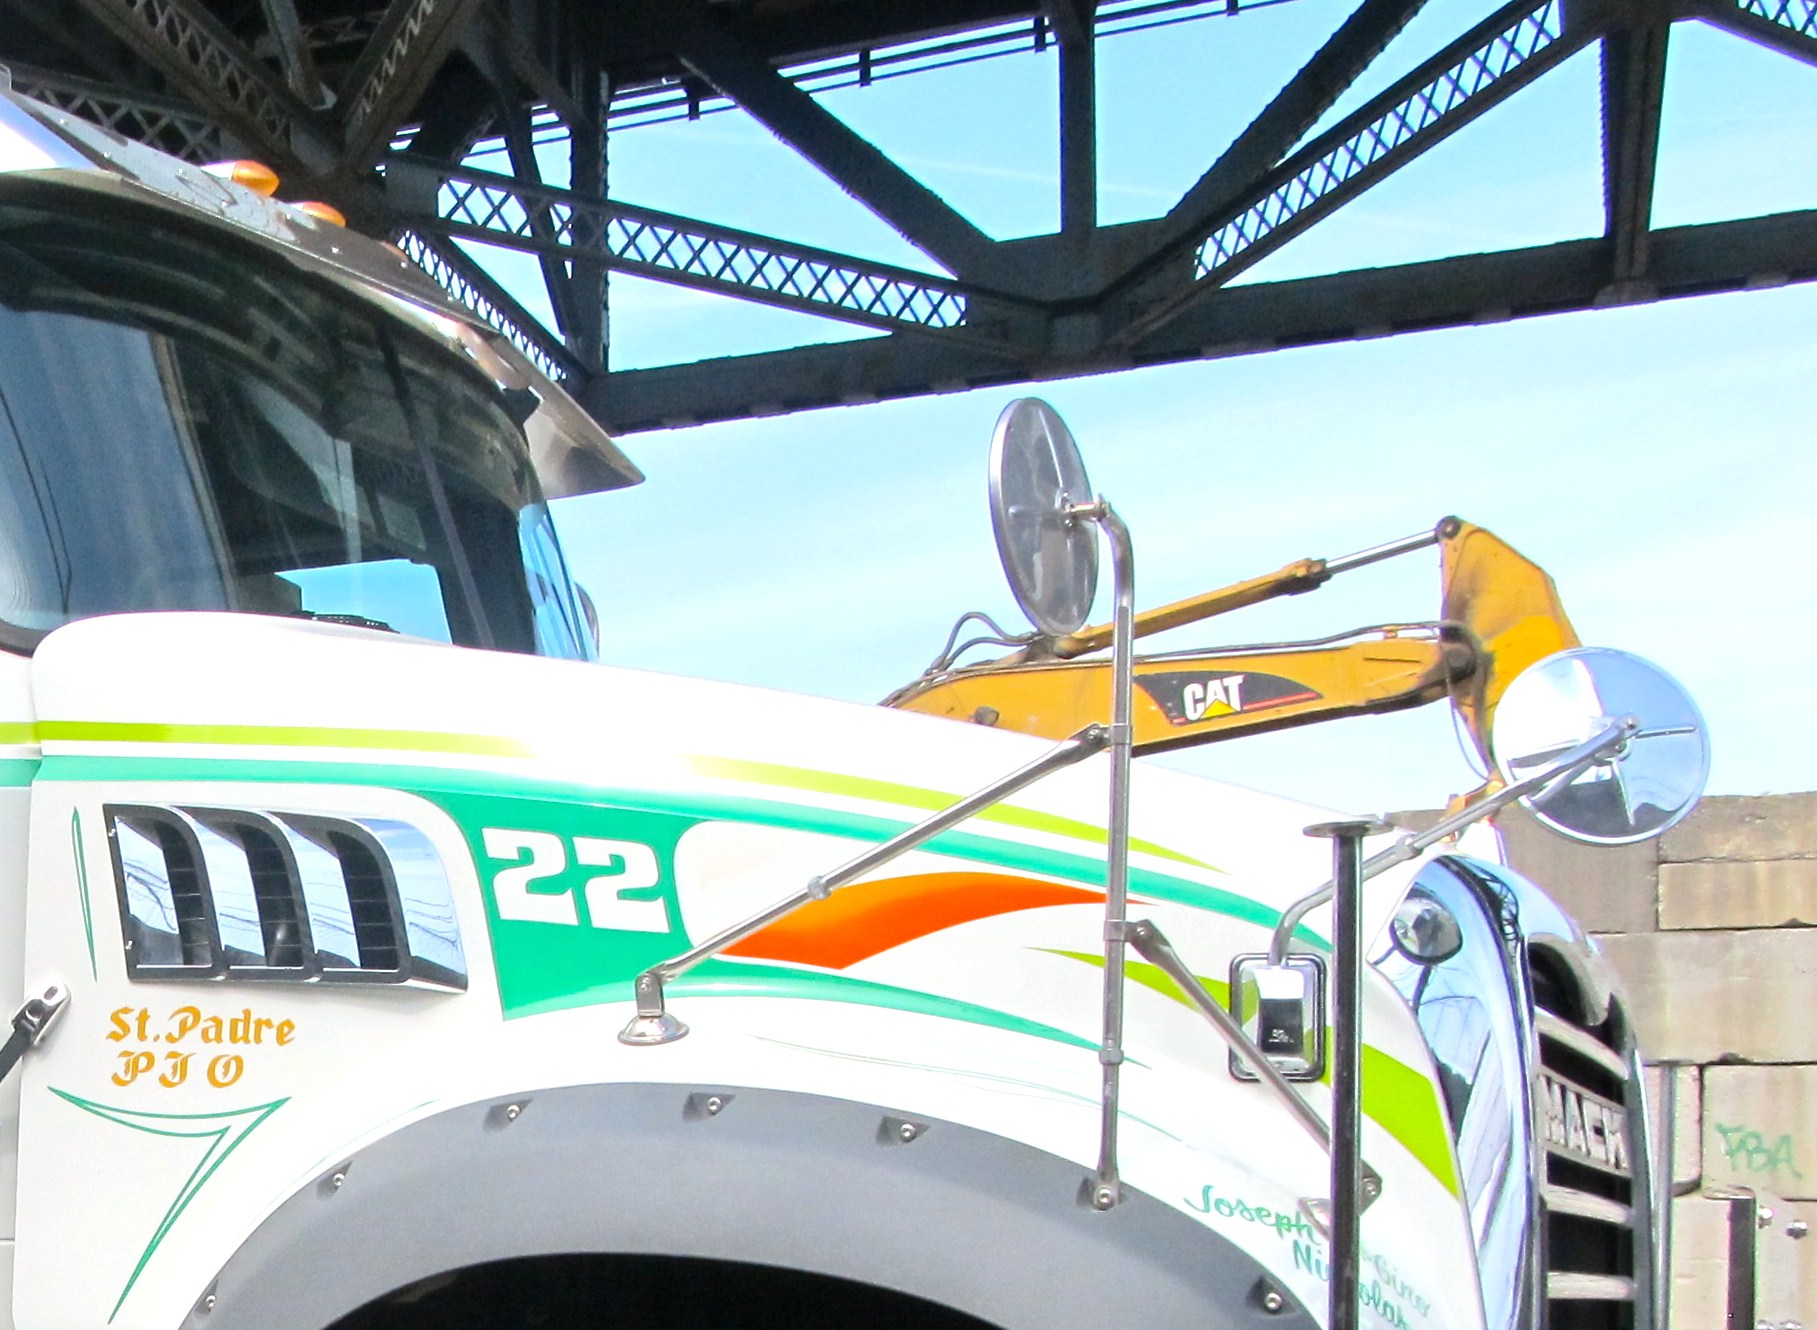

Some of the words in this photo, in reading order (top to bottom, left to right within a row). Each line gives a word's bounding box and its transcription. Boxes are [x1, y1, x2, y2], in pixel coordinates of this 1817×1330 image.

[1183, 673, 1245, 721] CAT
[481, 826, 671, 935] 22
[105, 1006, 161, 1043] St.
[164, 1005, 296, 1047] Padre
[1537, 1072, 1628, 1171] MACK
[1183, 1184, 1323, 1246] Joseph
